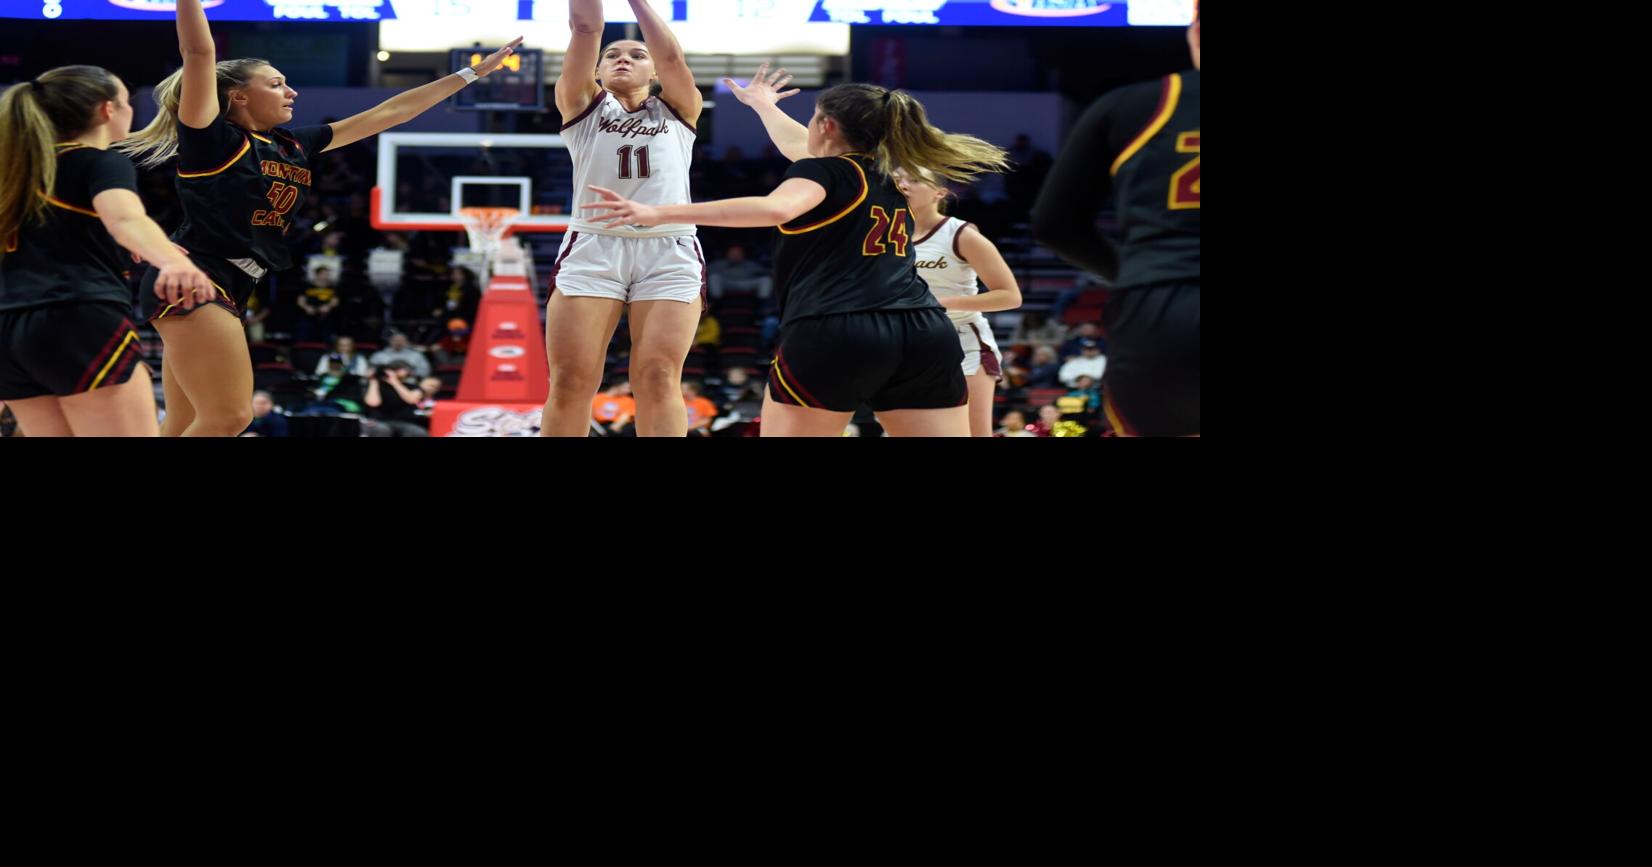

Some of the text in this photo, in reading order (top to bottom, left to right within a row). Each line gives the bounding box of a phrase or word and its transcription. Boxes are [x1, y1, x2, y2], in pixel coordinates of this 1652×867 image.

[616, 144, 651, 180] 11
[265, 181, 298, 215] 50
[862, 205, 909, 257] 24
